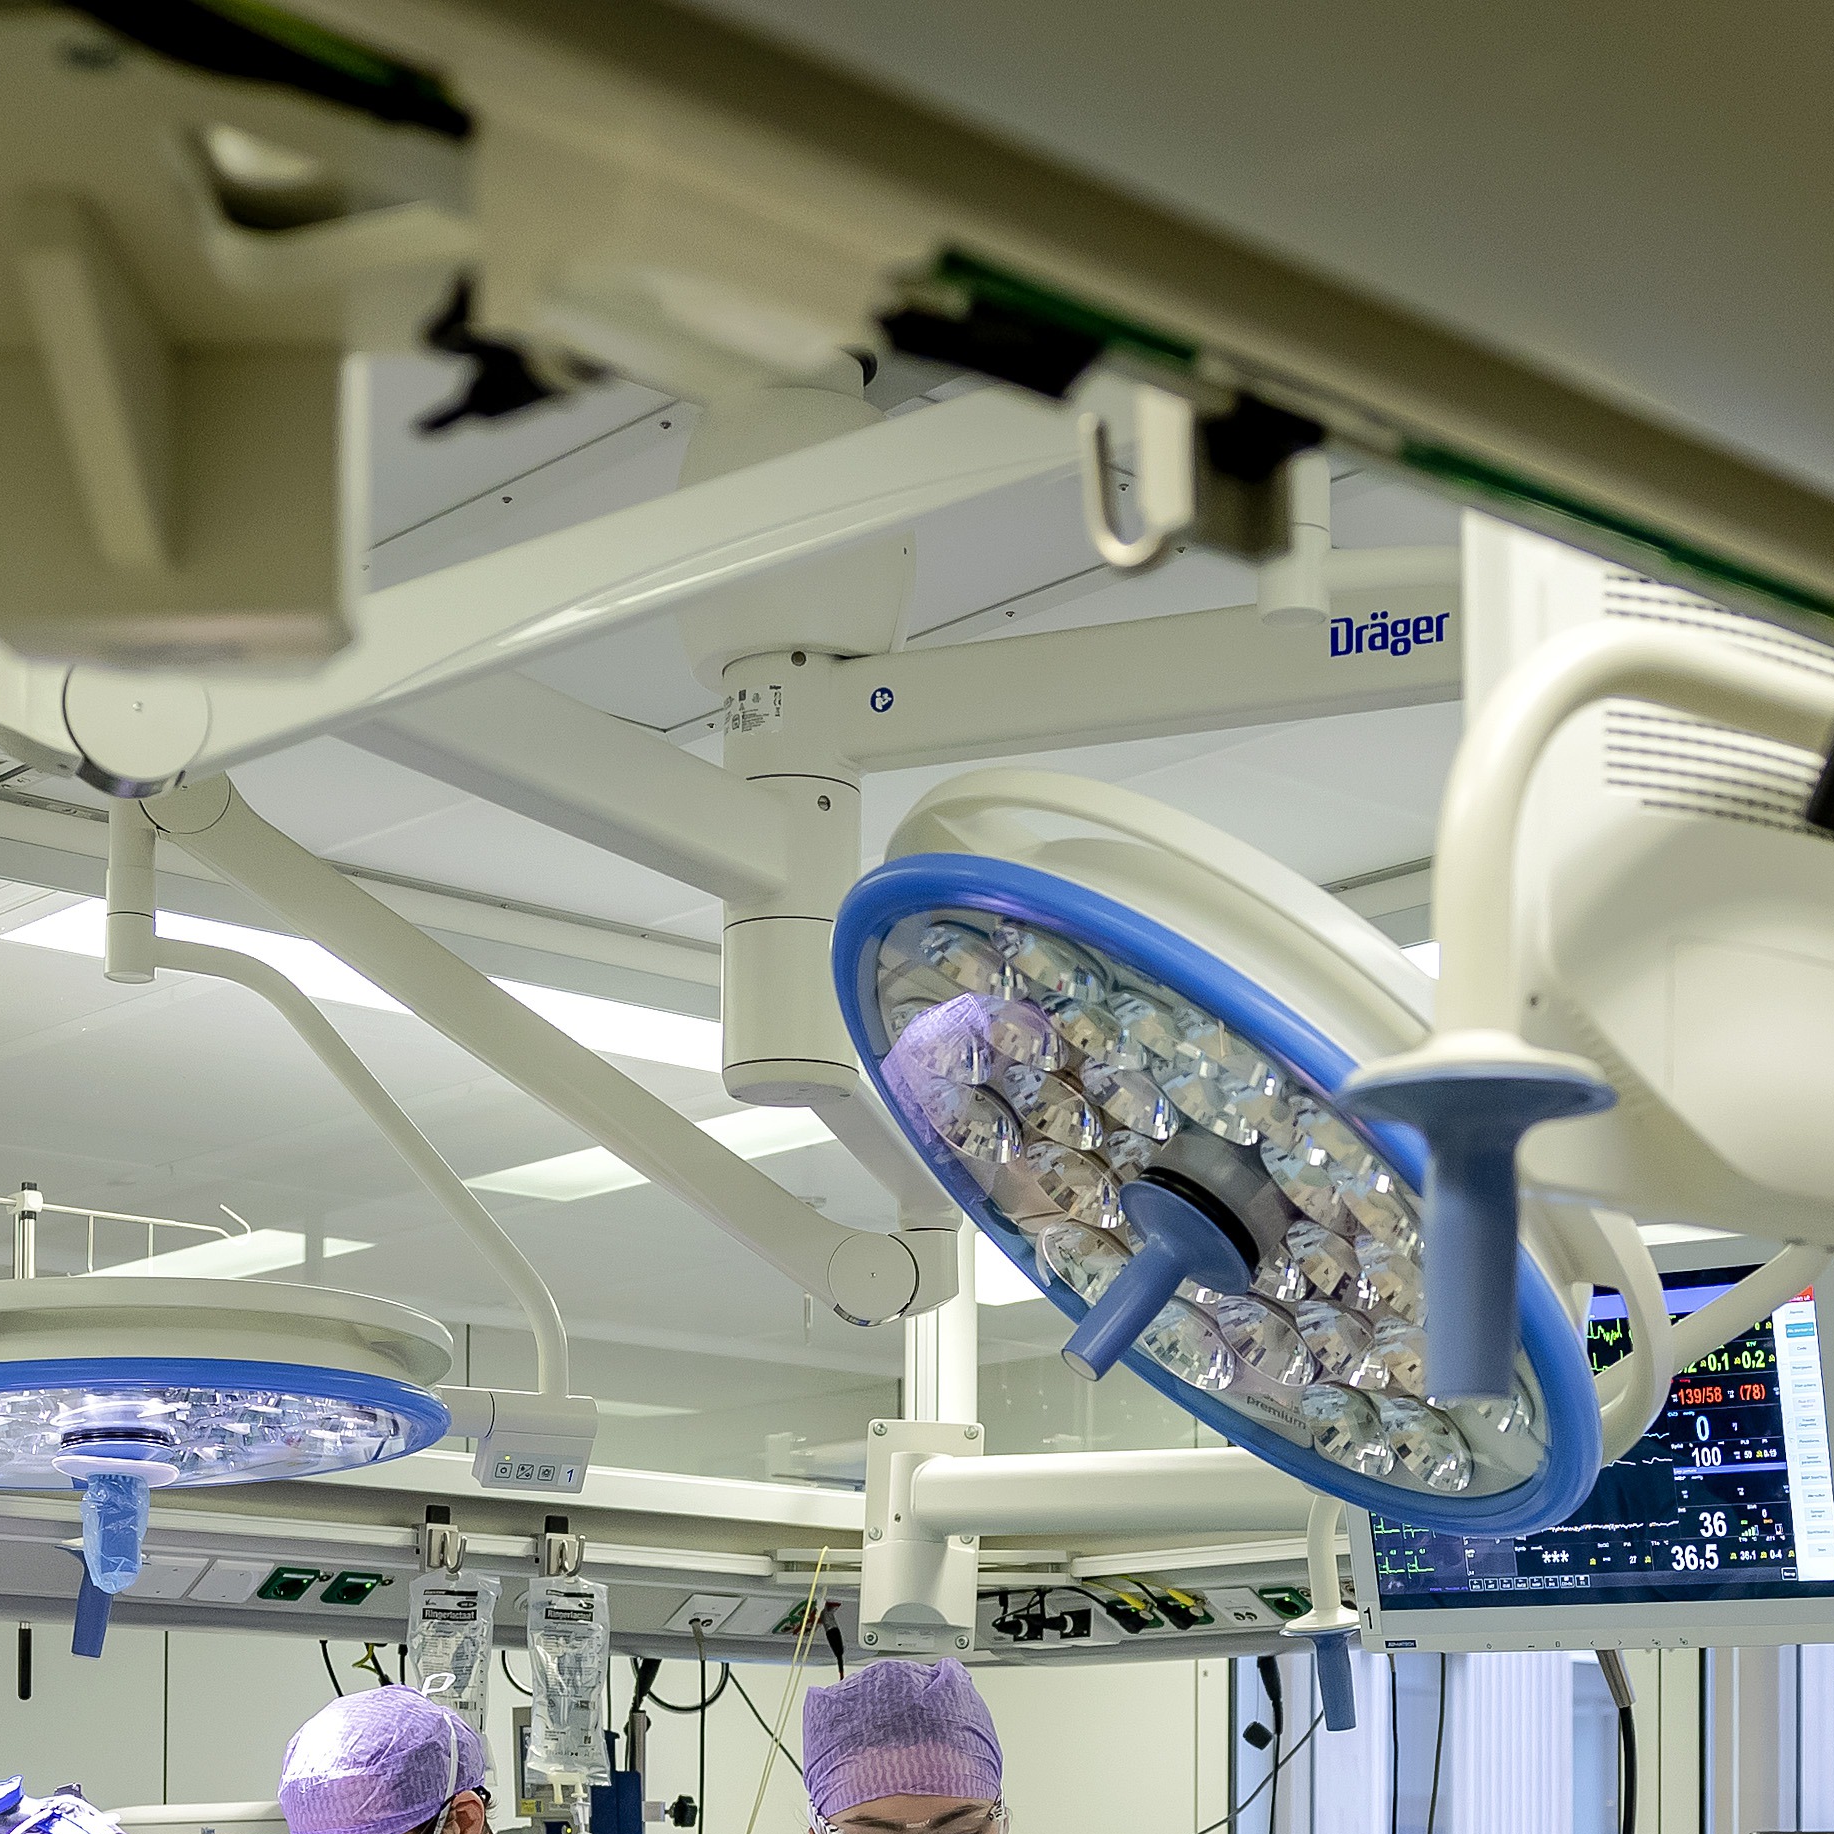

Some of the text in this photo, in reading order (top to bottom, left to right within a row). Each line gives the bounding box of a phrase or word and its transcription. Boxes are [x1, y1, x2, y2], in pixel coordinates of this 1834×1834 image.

[1330, 611, 1450, 657] Dräger
[1707, 1349, 1766, 1371] 0,1 0,2
[1678, 1383, 1766, 1405] 139/58 (78)
[1246, 1395, 1307, 1430] premium
[1696, 1415, 1710, 1441] 0
[1692, 1446, 1722, 1467] 100
[566, 1468, 575, 1483] 1
[1699, 1511, 1728, 1537] 36
[1670, 1543, 1720, 1571] 36,5
[425, 1609, 475, 1620] Ringerlactaat
[1363, 1606, 1373, 1630] 1
